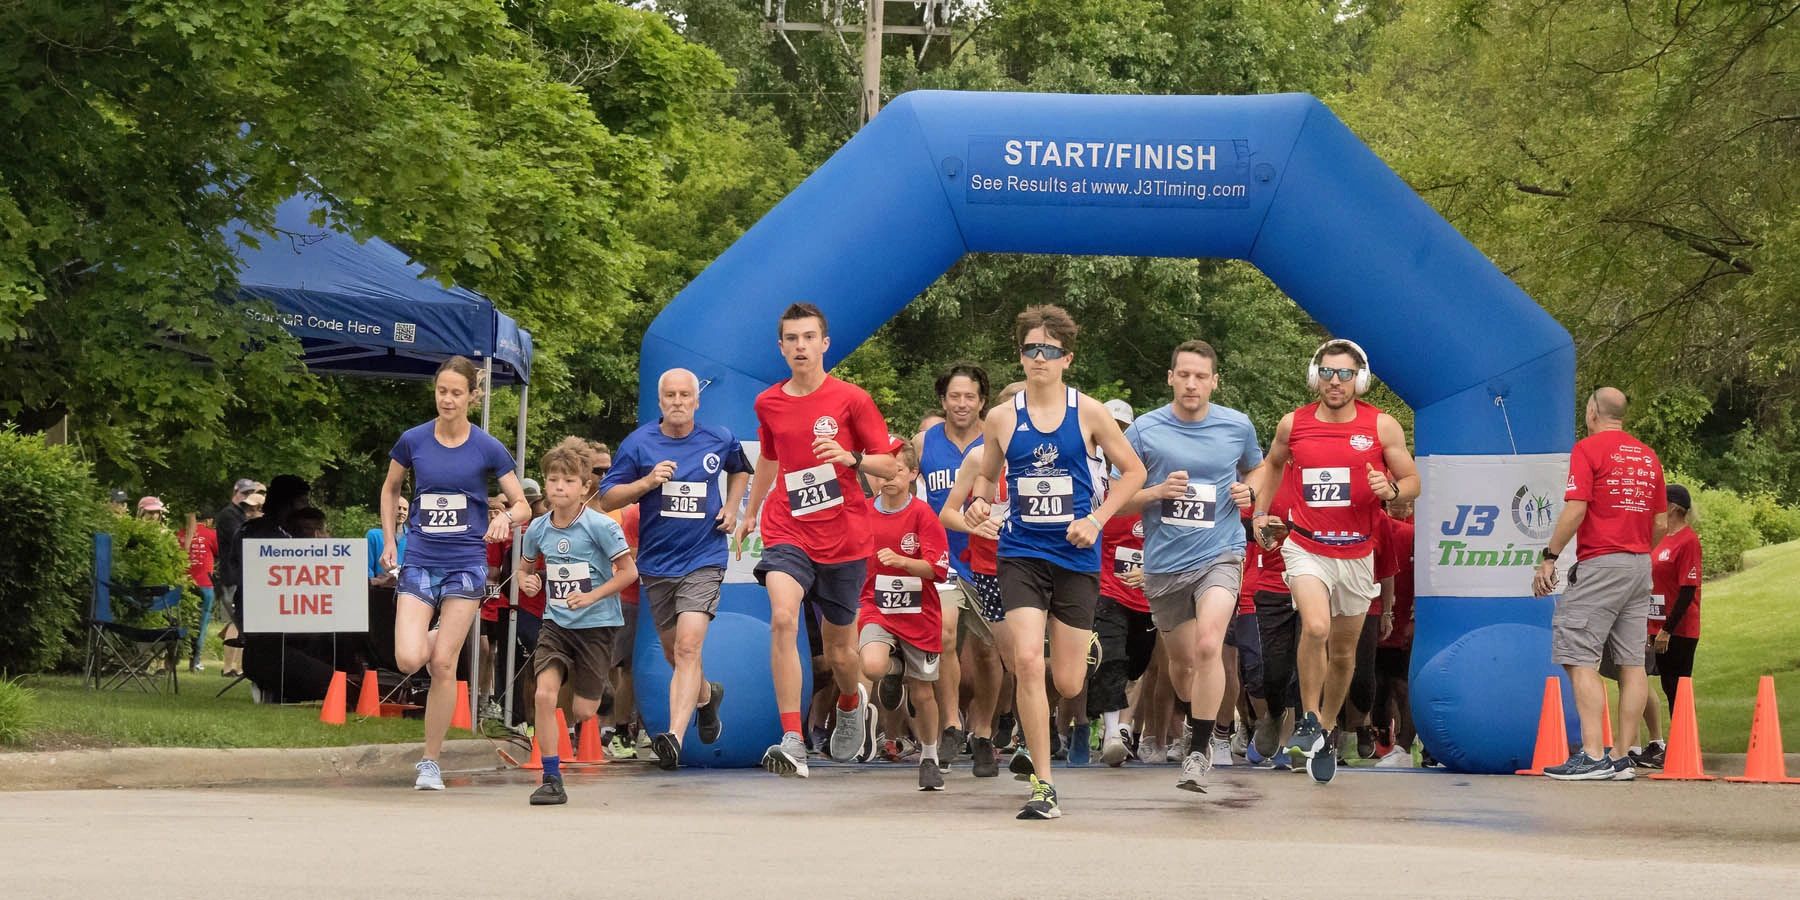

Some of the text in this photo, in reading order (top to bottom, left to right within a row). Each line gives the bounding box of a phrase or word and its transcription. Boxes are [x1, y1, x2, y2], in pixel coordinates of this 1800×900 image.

[1004, 139, 1216, 171] START/FINISH
[971, 174, 1003, 191] See
[1007, 175, 1067, 194] Results
[1072, 179, 1087, 194] at
[308, 316, 344, 331] Code
[347, 320, 381, 335] Here
[798, 484, 831, 507] 231
[1311, 484, 1341, 501] 372
[670, 497, 698, 512] 305
[1029, 497, 1063, 516] 240
[1172, 500, 1205, 520] 373
[428, 510, 458, 526] 223
[1441, 504, 1500, 537] J3
[259, 544, 352, 557] Memorial 5K
[267, 564, 345, 587] START
[279, 593, 333, 615] LINE
[882, 592, 912, 608] 324
